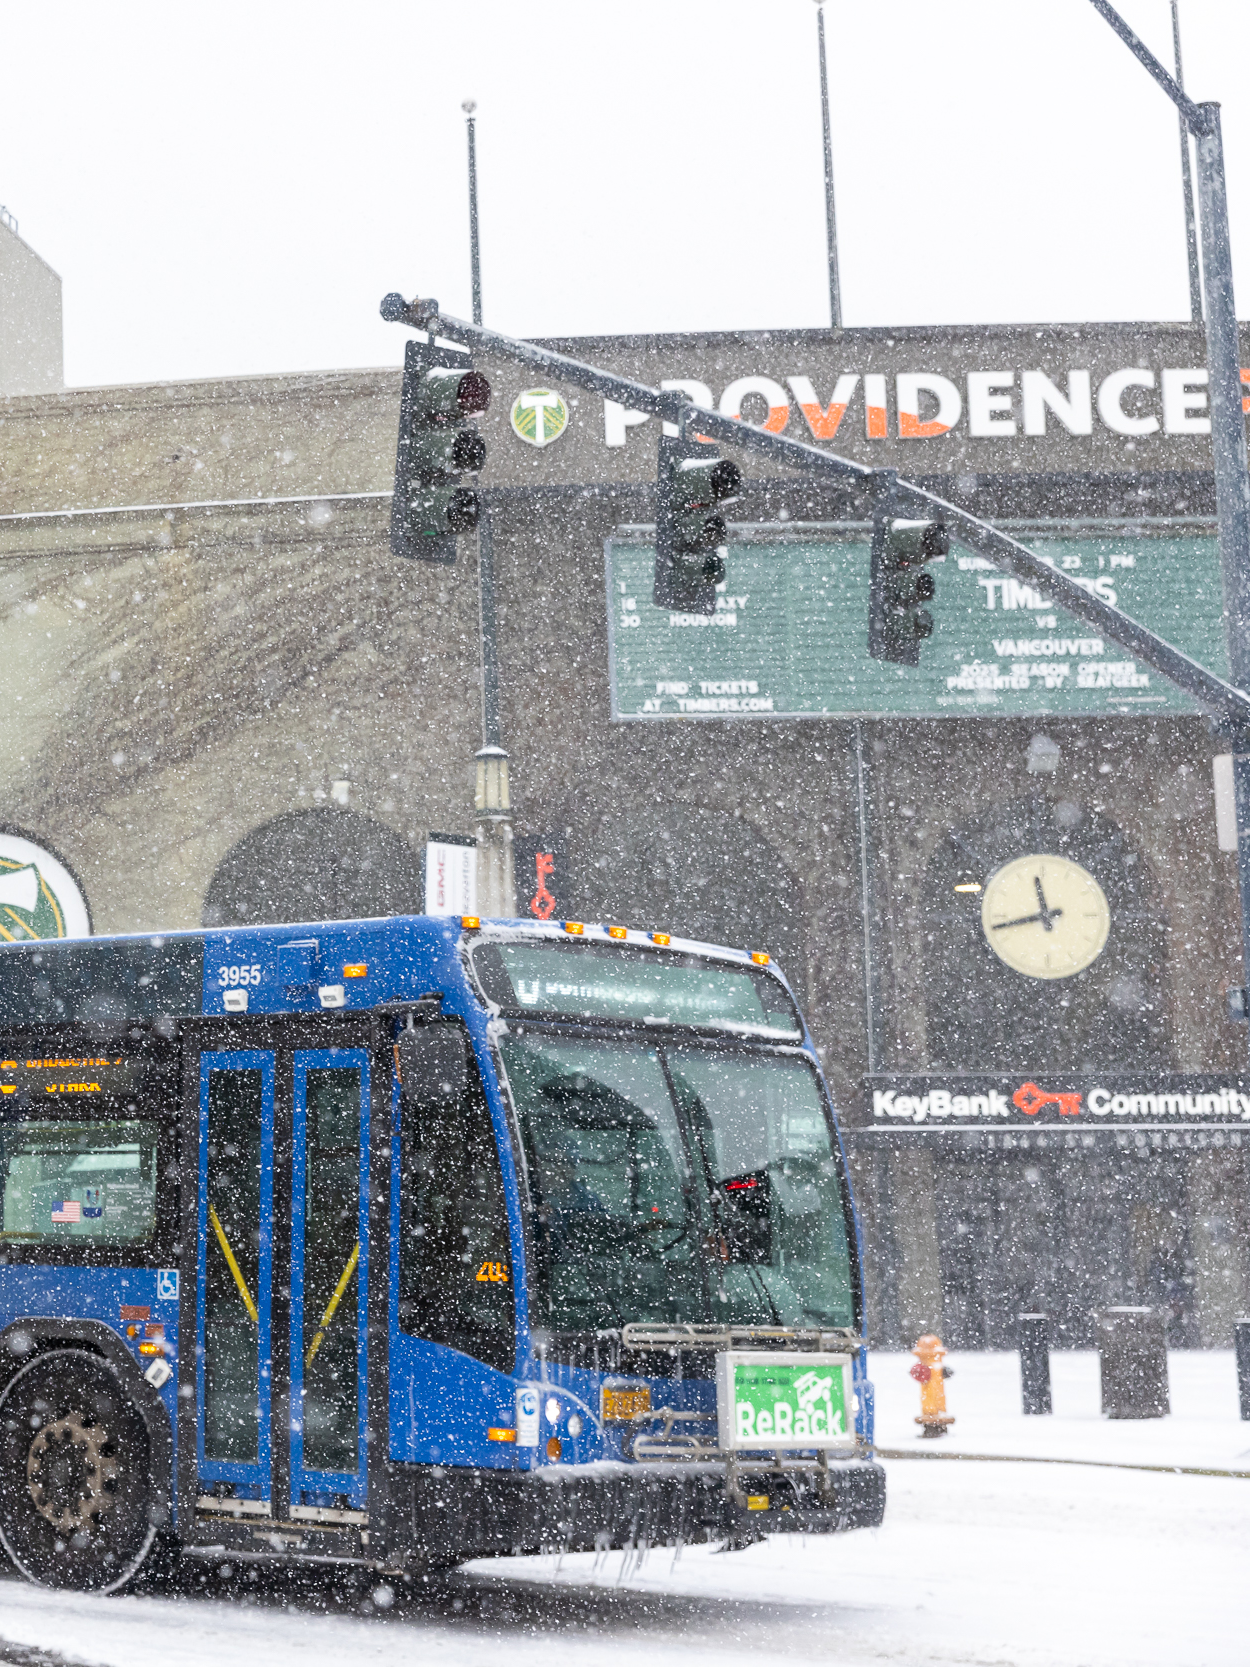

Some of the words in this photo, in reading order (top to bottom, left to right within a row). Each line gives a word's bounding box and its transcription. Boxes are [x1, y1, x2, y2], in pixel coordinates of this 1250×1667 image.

[1110, 554, 1135, 568] PM
[978, 576, 1117, 610] TIMS
[620, 615, 641, 627] 30
[669, 614, 737, 626] HOUSTON
[1035, 615, 1057, 628] VS
[992, 638, 1105, 656] VANCOUVER
[1011, 662, 1070, 676] SEASON
[656, 681, 689, 695] FIND
[699, 680, 759, 694] TICKETS
[946, 676, 1030, 690] PRESENTED
[1044, 676, 1064, 689] BY
[642, 700, 661, 712] AT
[437, 849, 446, 907] GMC
[218, 965, 261, 986] 3955
[873, 1089, 1010, 1122] KeyBank
[1087, 1088, 1250, 1120] Community
[736, 1401, 842, 1438] ReRack
